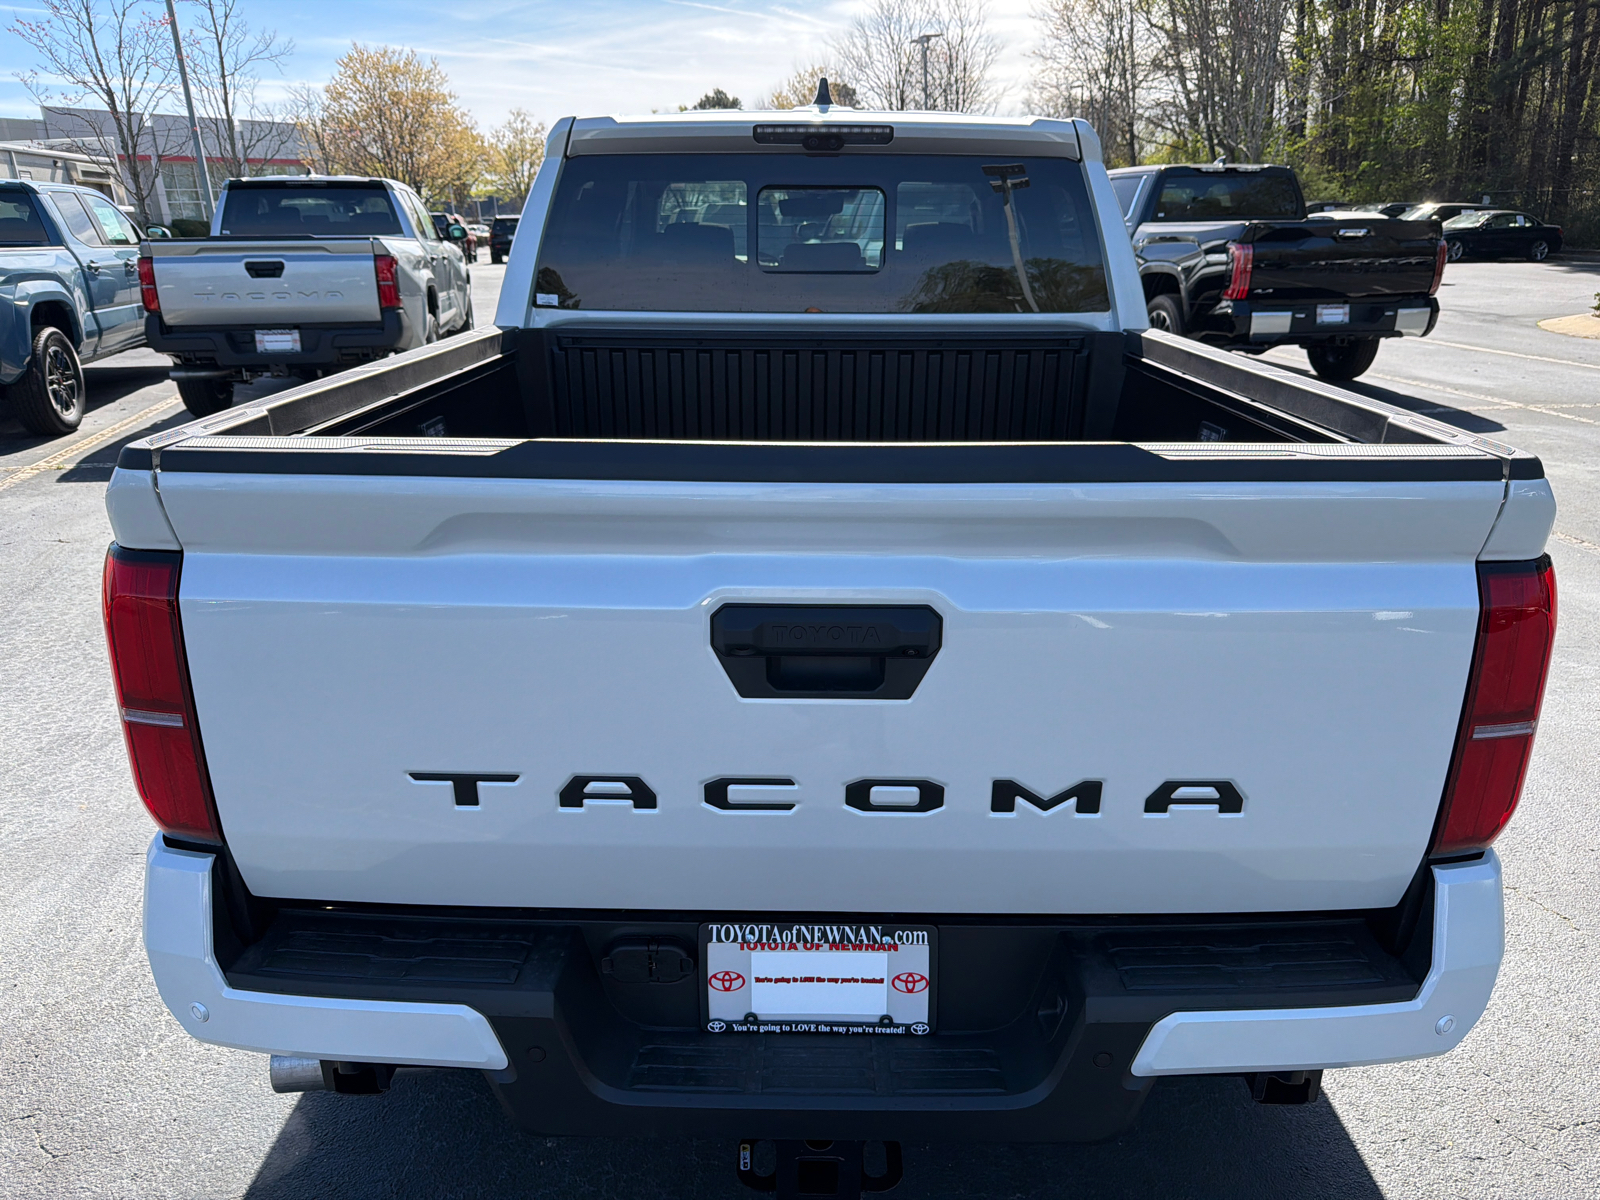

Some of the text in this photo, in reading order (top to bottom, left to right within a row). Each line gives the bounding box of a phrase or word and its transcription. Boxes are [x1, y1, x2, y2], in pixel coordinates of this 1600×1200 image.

[194, 290, 344, 300] TACOMA
[772, 625, 881, 643] TOYOTA
[405, 771, 1245, 815] TACOMA
[732, 1023, 906, 1034] You're going to LOVE the way you're treated!
